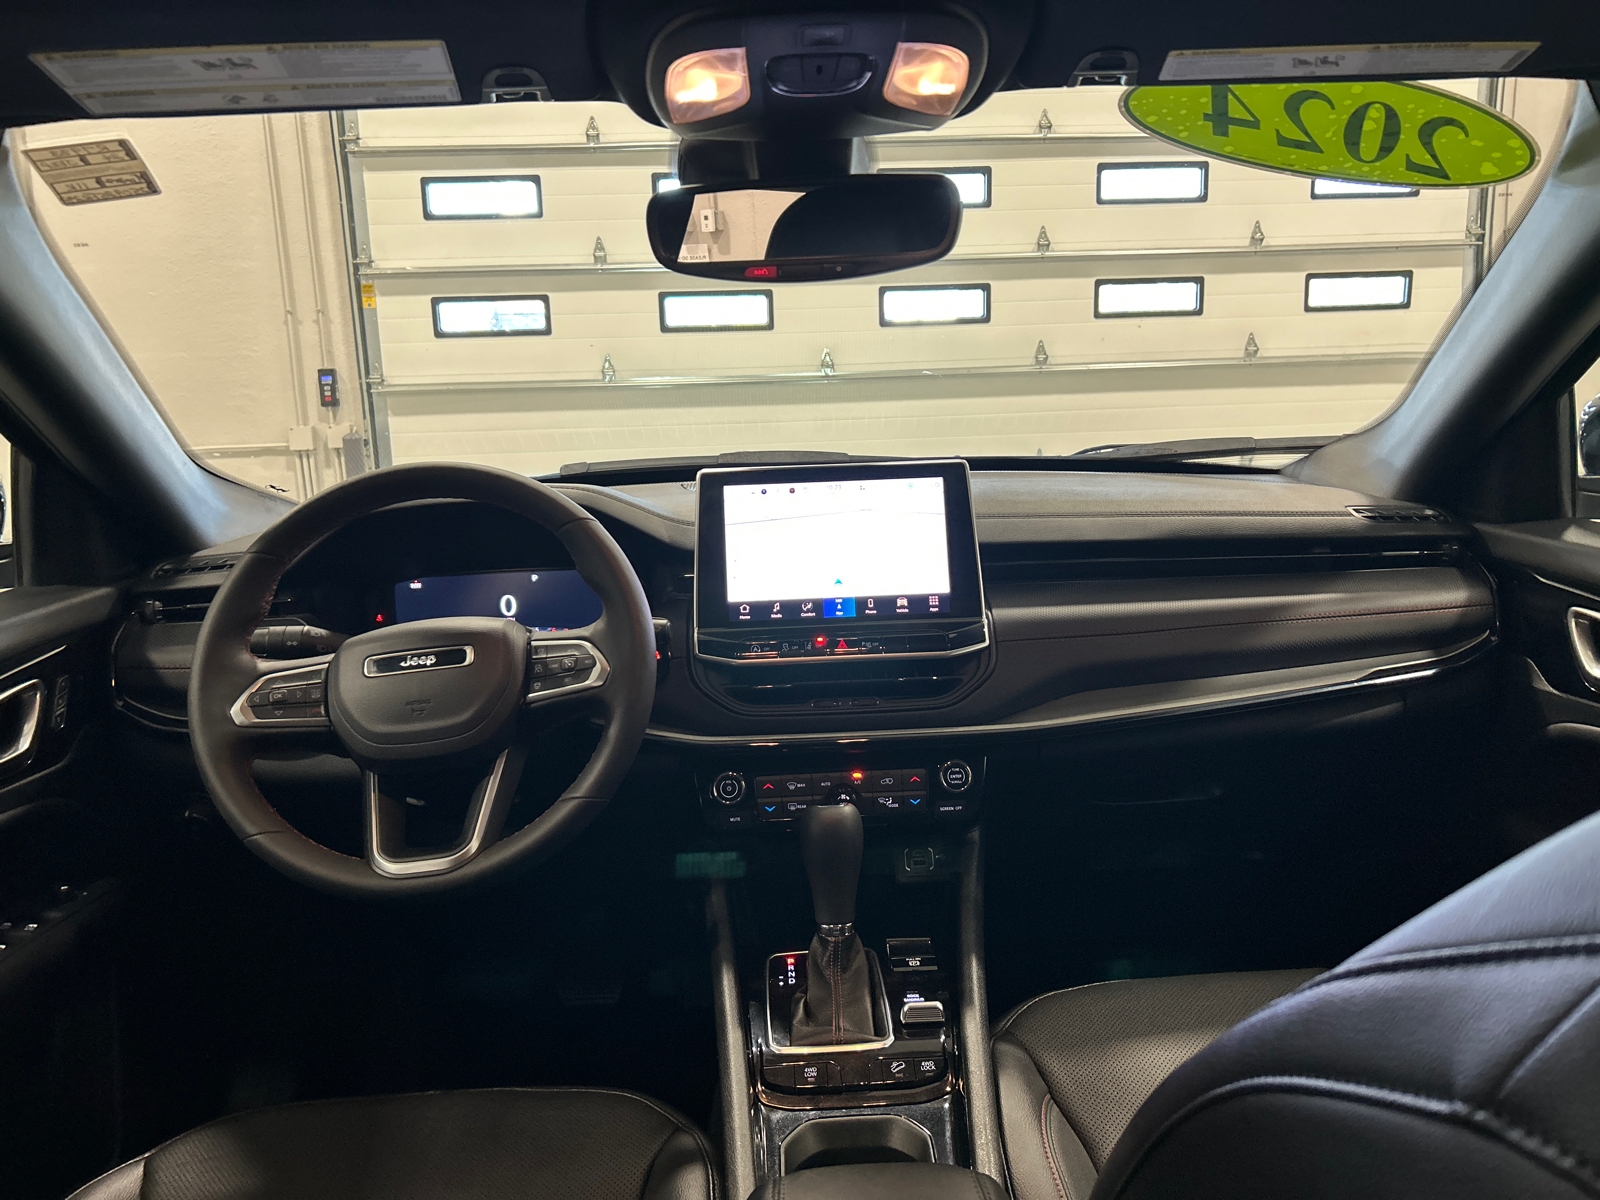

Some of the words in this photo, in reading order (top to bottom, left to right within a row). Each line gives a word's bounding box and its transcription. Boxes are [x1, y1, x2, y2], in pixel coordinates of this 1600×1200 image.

[531, 574, 539, 582] P
[500, 594, 517, 617] 0
[400, 654, 436, 667] Jeep
